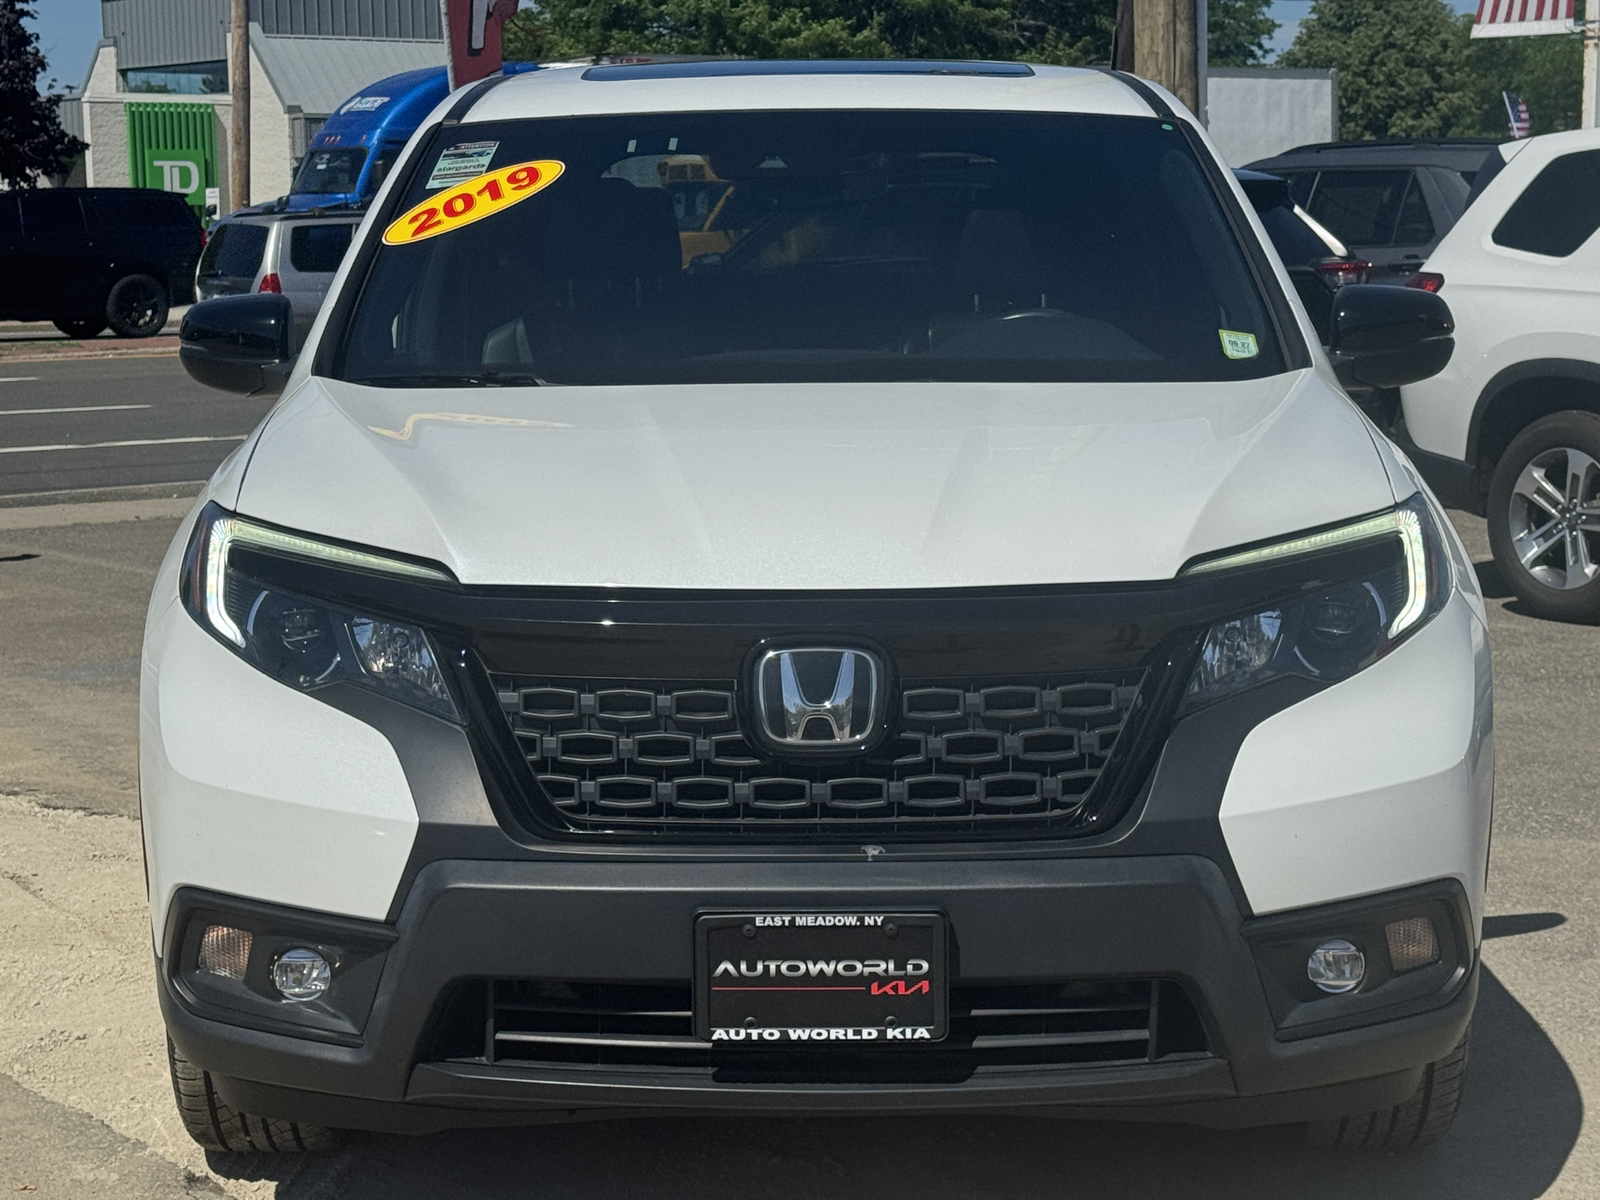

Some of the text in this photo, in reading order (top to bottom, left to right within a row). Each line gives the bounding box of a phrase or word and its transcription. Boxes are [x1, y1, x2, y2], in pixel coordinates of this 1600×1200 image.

[153, 160, 199, 194] TD
[408, 166, 542, 238] 2019
[755, 916, 791, 926] EAST
[864, 916, 884, 926] NY
[713, 959, 929, 977] AUTOWORLD
[711, 1028, 931, 1040] AUTO WORLD KIA
